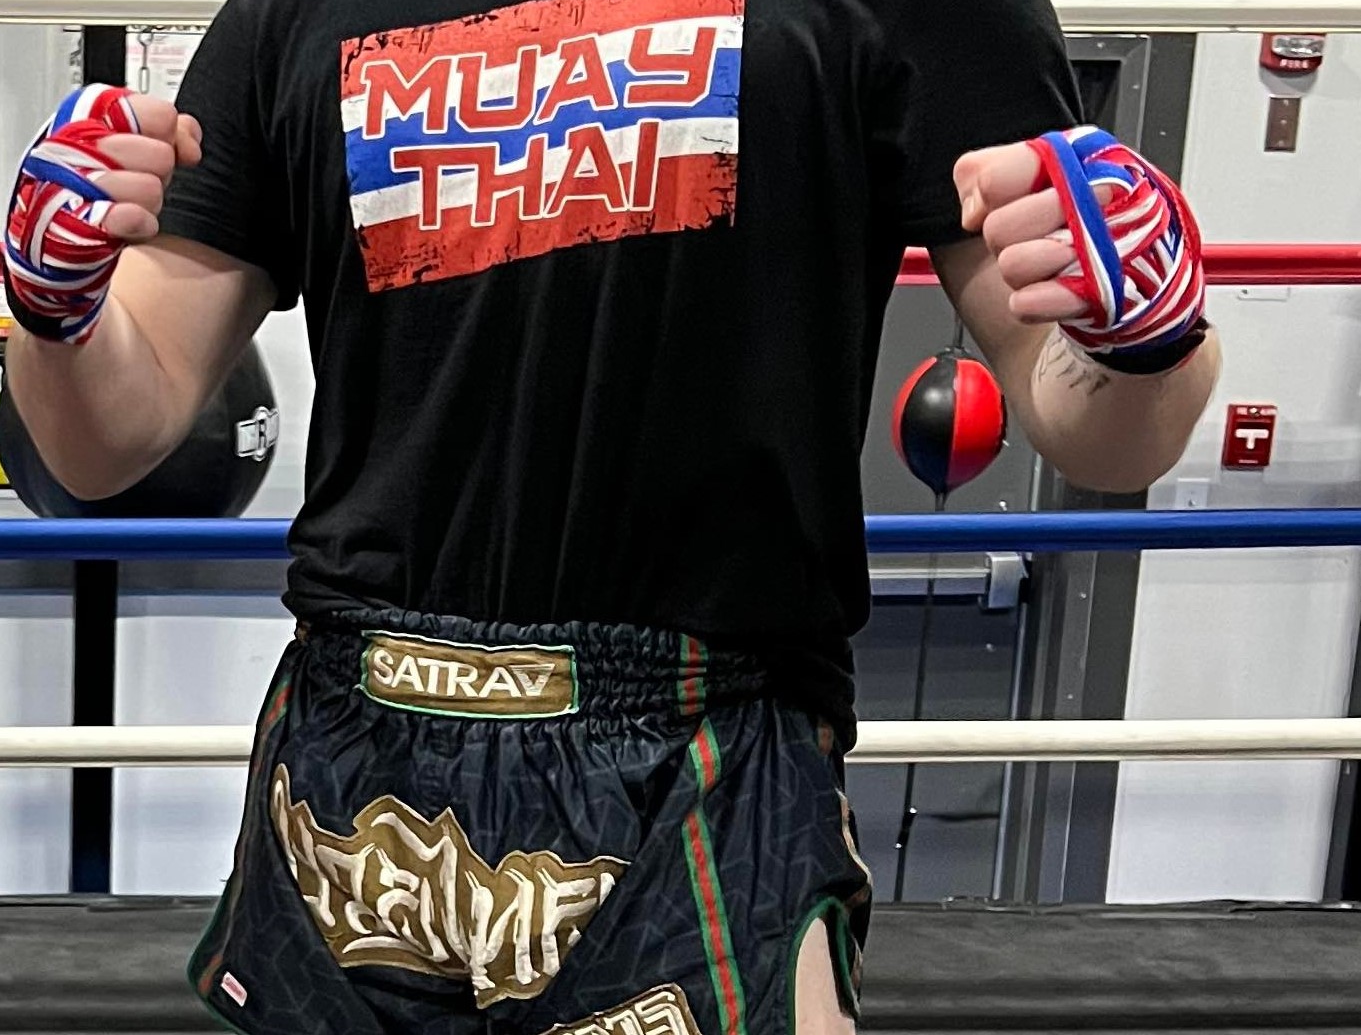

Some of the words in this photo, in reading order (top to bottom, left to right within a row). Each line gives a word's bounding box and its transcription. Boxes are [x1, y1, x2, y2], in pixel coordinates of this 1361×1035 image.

[362, 26, 717, 139] MUAY
[391, 118, 661, 231] THAI
[372, 649, 556, 698] SATRAV
